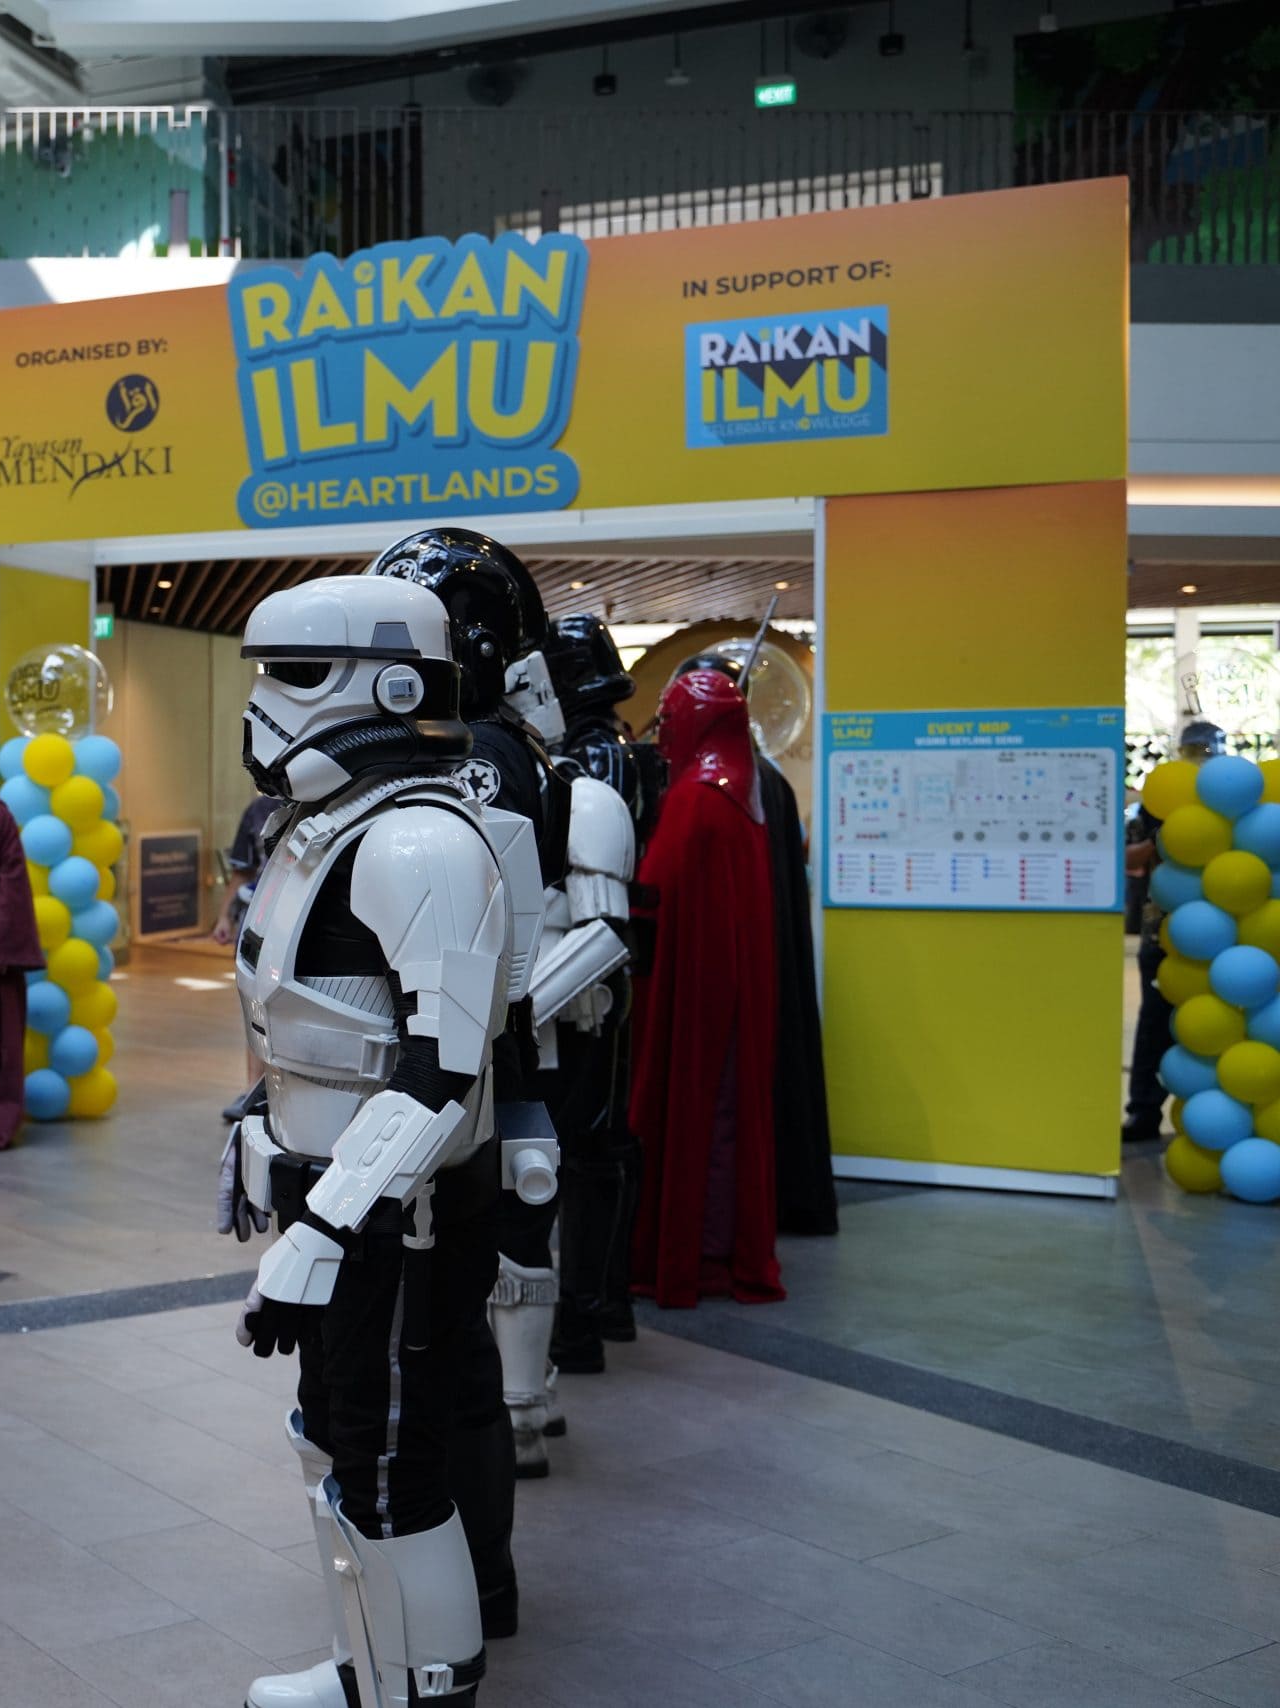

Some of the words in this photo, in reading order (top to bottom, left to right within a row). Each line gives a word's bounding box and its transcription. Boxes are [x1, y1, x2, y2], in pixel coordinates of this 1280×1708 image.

[682, 280, 708, 298] IN
[716, 265, 840, 295] SUPPORT
[847, 260, 893, 281] OF:
[15, 341, 131, 368] ORGANISED
[137, 338, 168, 355] BY:
[251, 341, 557, 461] ILMU
[701, 355, 871, 423] ILMU
[705, 420, 775, 438] ELEBRATE
[253, 465, 560, 518] @HEARTLANDS
